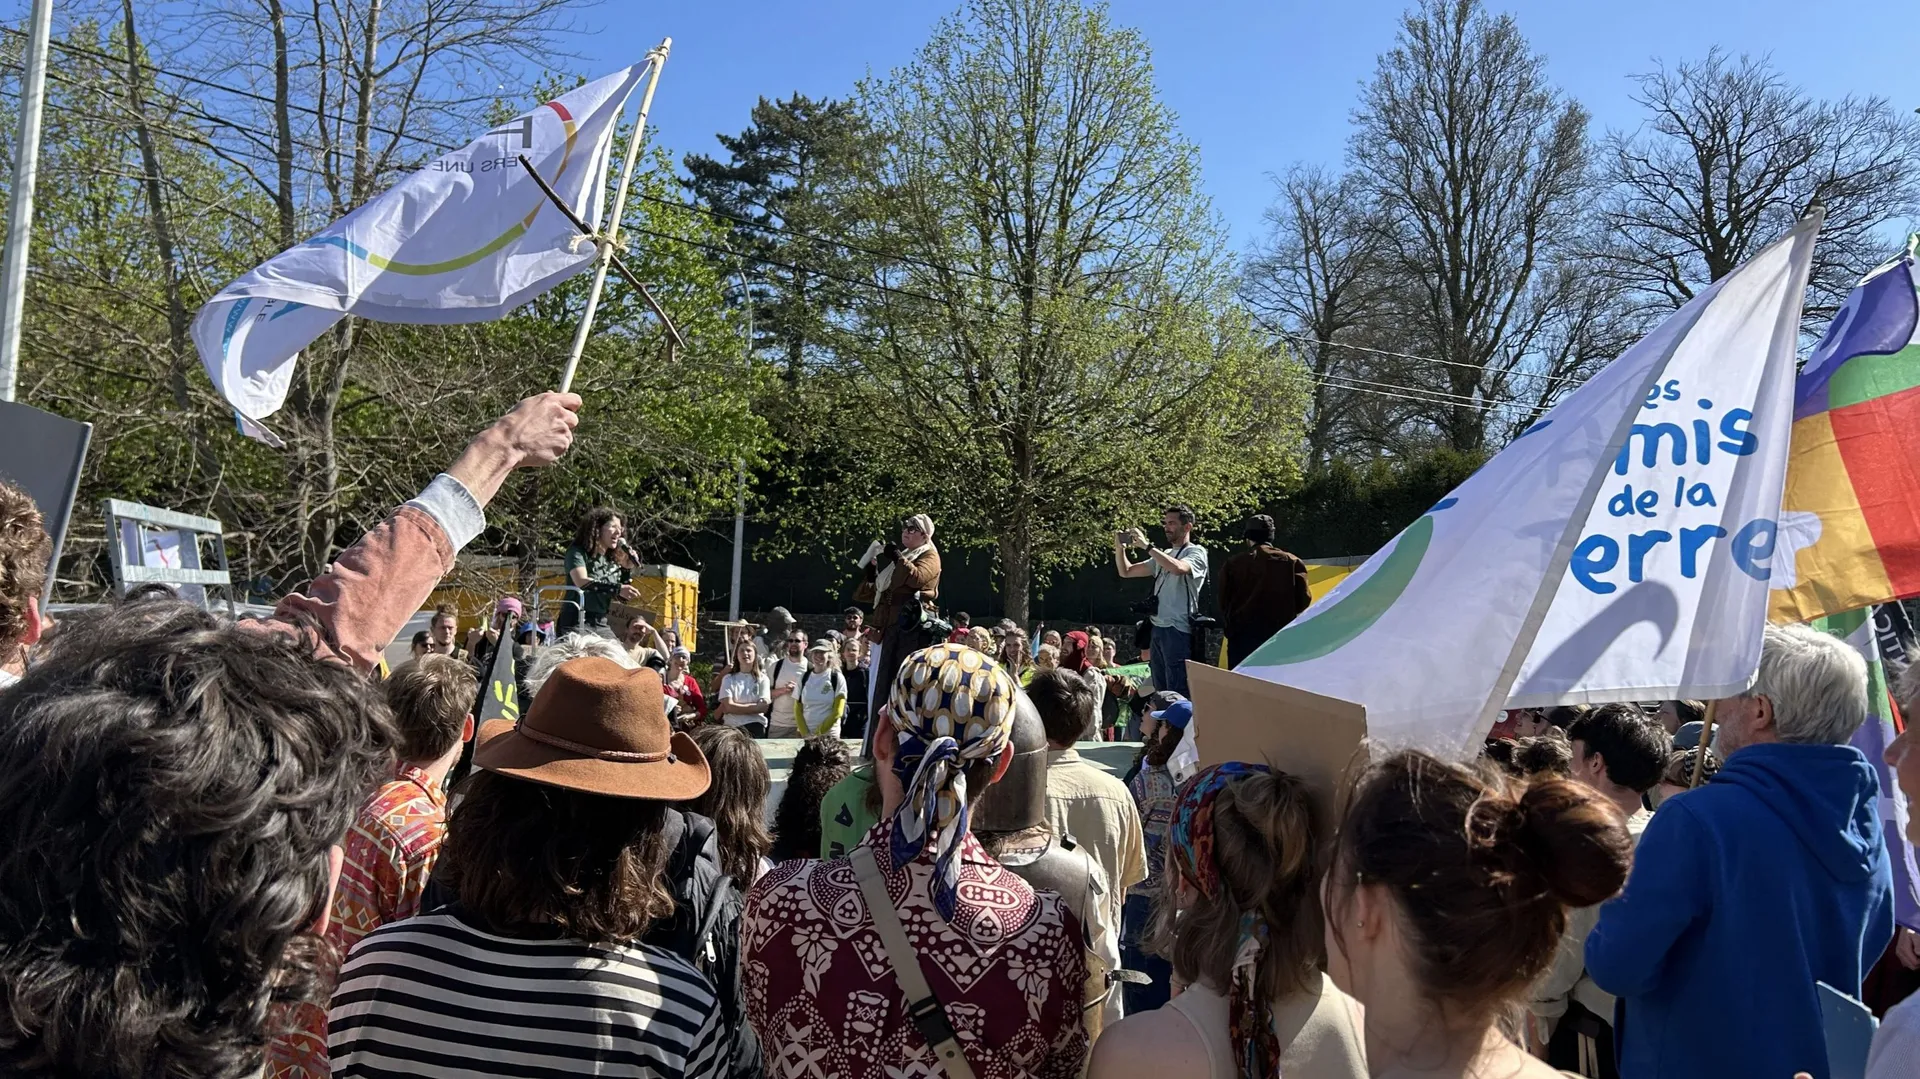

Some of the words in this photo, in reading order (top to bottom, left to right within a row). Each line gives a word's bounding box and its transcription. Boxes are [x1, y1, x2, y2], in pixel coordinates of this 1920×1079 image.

[1643, 379, 1681, 409] es
[1615, 398, 1759, 476] mis
[1608, 484, 1659, 518] de
[1674, 476, 1717, 508] la
[1570, 518, 1778, 594] erre
